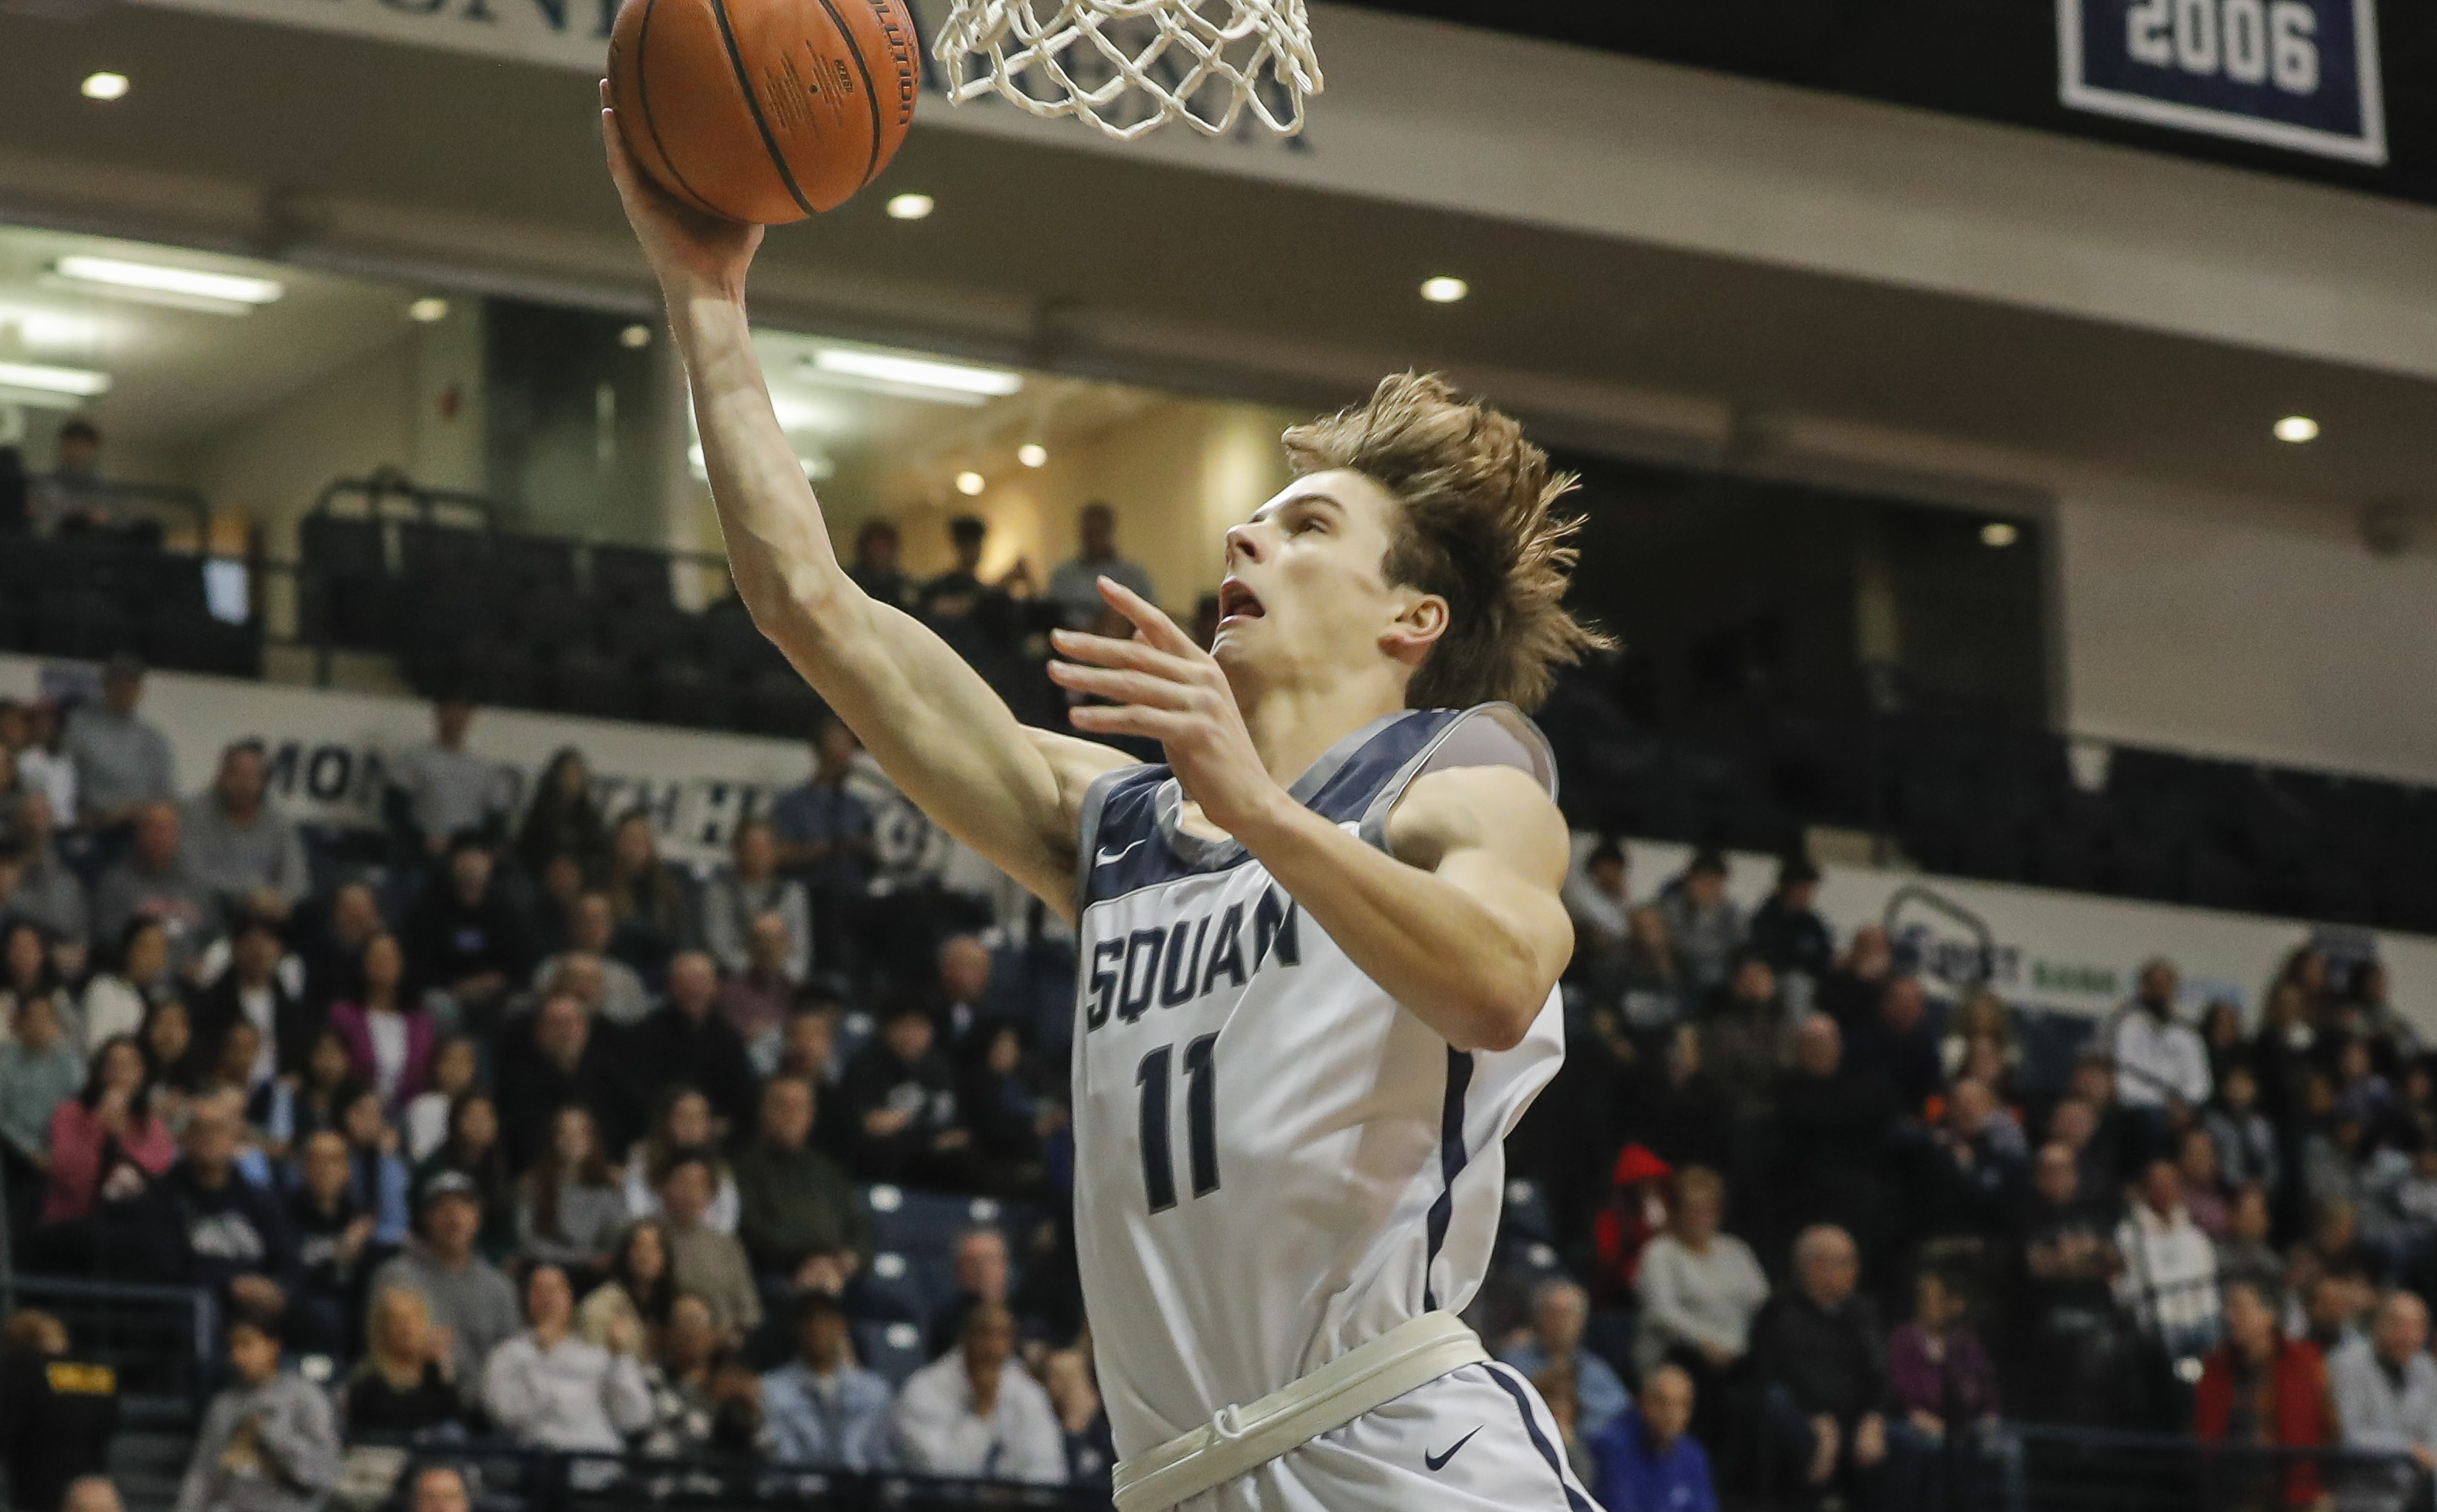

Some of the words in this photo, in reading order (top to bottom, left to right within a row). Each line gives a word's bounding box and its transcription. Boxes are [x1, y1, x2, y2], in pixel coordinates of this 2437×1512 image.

[868, 0, 912, 125] LUTION
[2126, 0, 2318, 95] 2006
[1086, 885, 1300, 1033] SQUAN
[1135, 1031, 1221, 1215] 11
